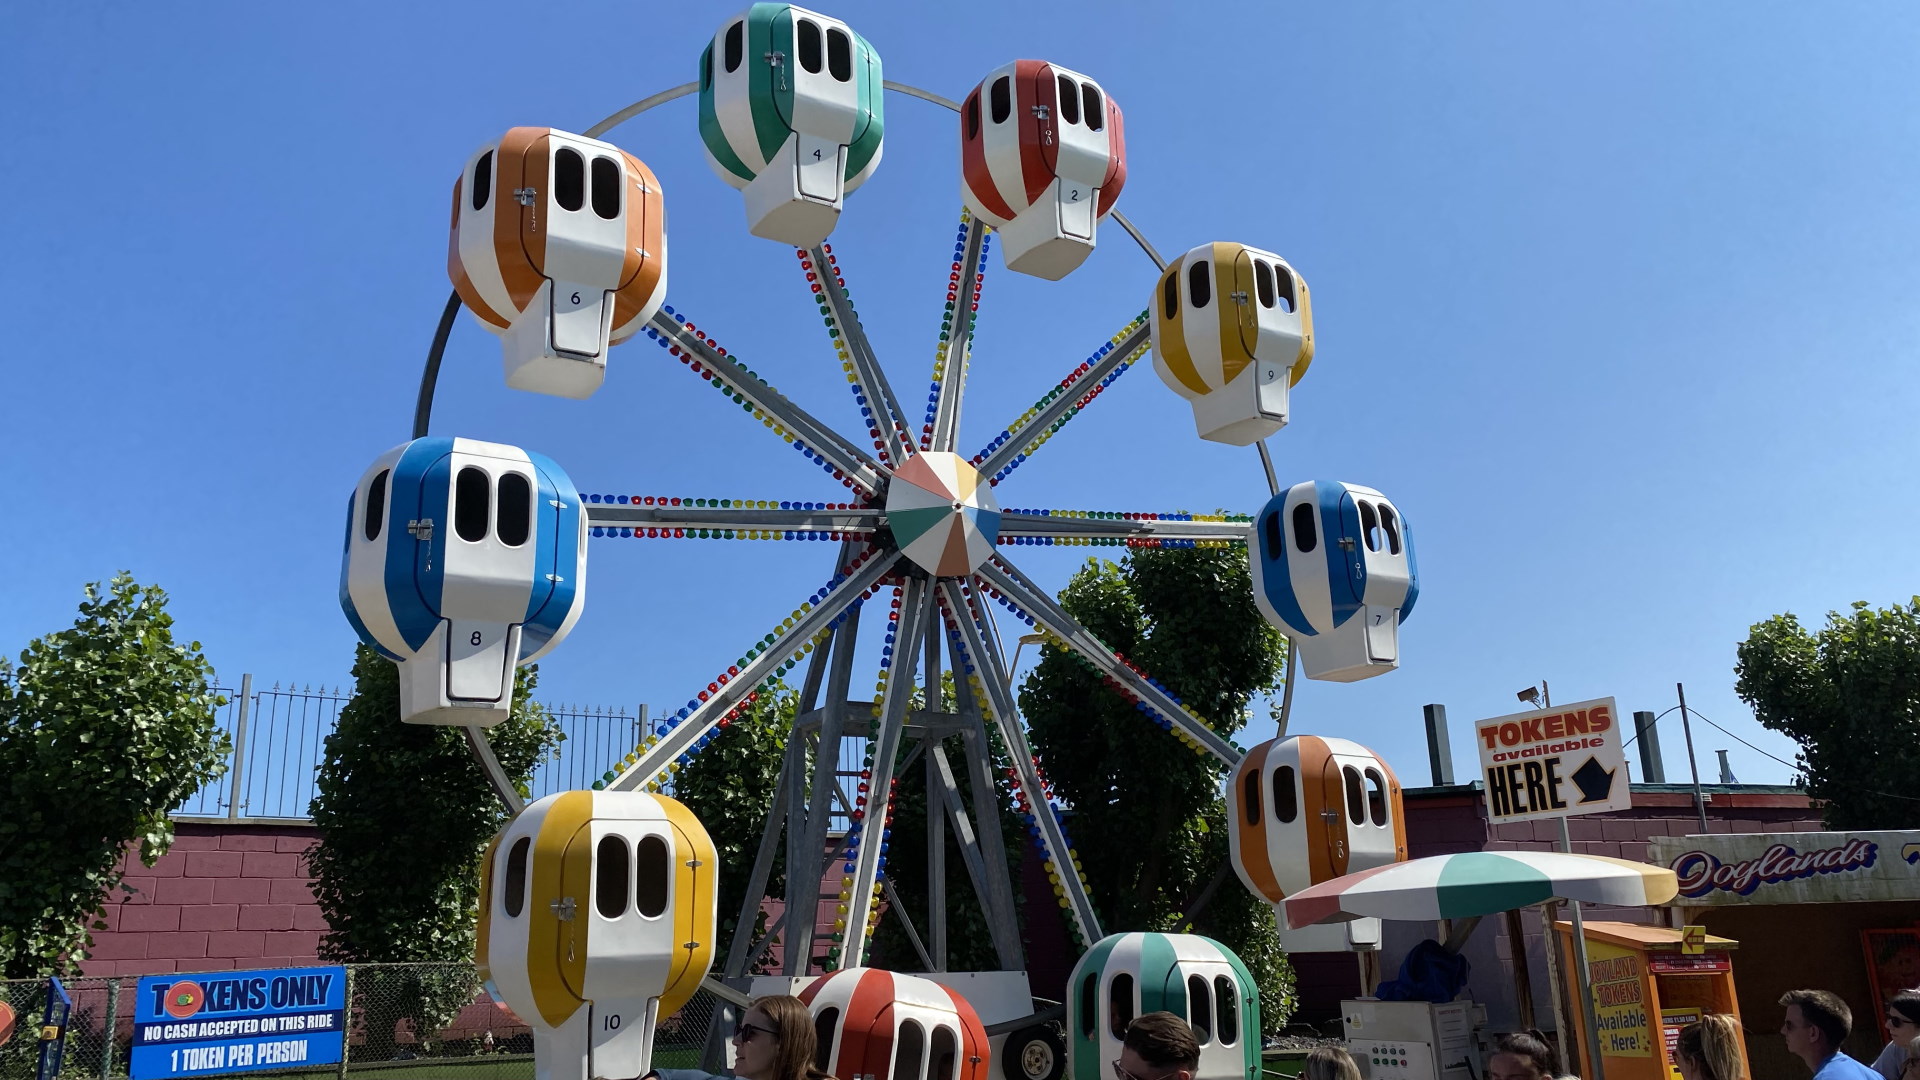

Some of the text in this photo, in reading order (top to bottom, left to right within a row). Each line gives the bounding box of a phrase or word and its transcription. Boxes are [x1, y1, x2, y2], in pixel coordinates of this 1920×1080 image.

[813, 149, 821, 161] 4
[1071, 190, 1080, 201] 2
[570, 292, 581, 305] 6
[1268, 370, 1275, 380] 9
[1375, 614, 1382, 625] 7
[470, 631, 482, 646] 8
[1480, 706, 1612, 750] TOKENS
[1493, 738, 1605, 762] available
[1487, 756, 1567, 817] HERE
[1590, 956, 1639, 983] JOYLAND
[270, 974, 333, 1009] ONLY
[1596, 980, 1643, 1008] TOKENS
[144, 1014, 333, 1041] NO CASH ACCEPTED ON THIS RIDE
[604, 1014, 620, 1030] 10
[1597, 1008, 1647, 1031] Available
[1610, 1031, 1641, 1052] Here!
[171, 1040, 308, 1072] 1 TOKEN PER PERSON
